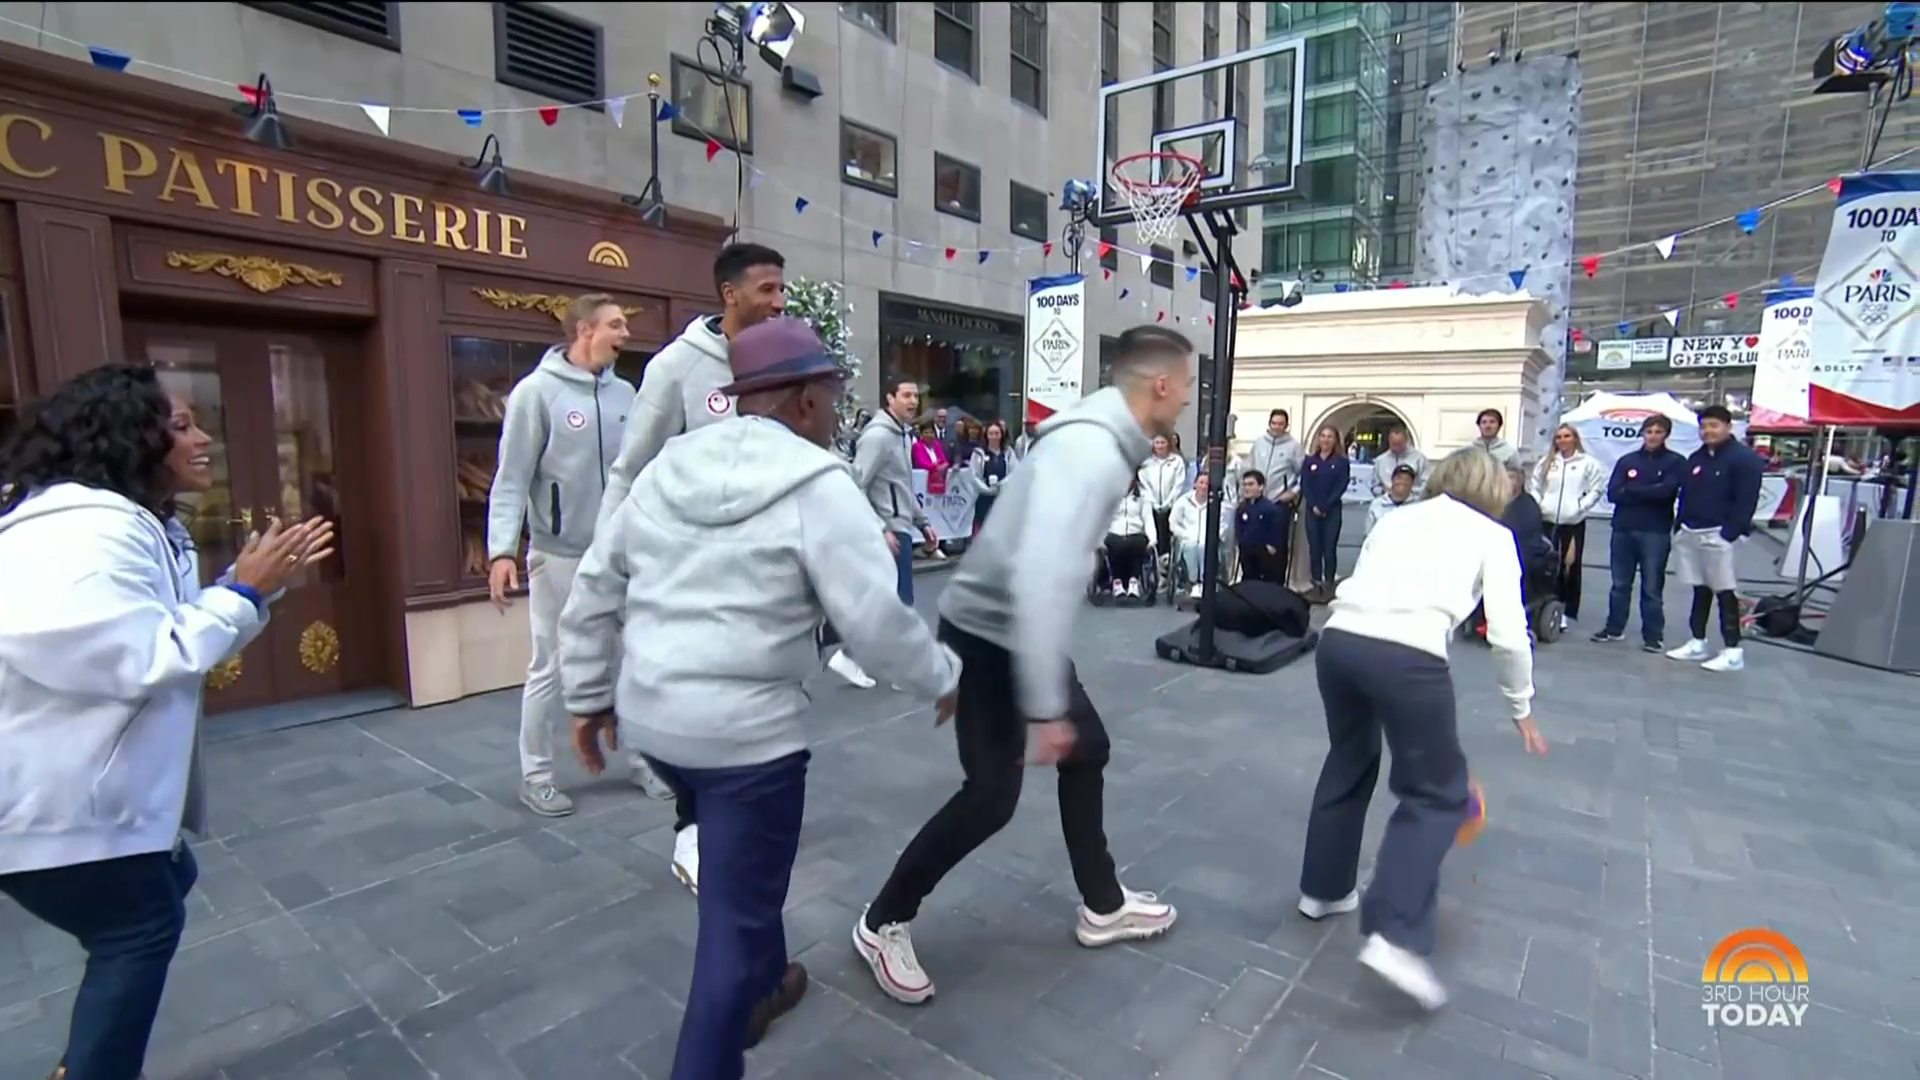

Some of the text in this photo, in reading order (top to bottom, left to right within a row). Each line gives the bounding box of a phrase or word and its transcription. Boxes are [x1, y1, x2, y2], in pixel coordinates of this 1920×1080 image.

[98, 132, 529, 260] PATISSERIE
[1847, 207, 1920, 229] 100 DA
[1881, 229, 1896, 242] TO
[1845, 283, 1911, 303] PARIS
[1037, 294, 1079, 308] 100 DAYS
[1773, 306, 1801, 320] 100
[1682, 337, 1724, 351] NEW
[1778, 348, 1810, 360] PARI
